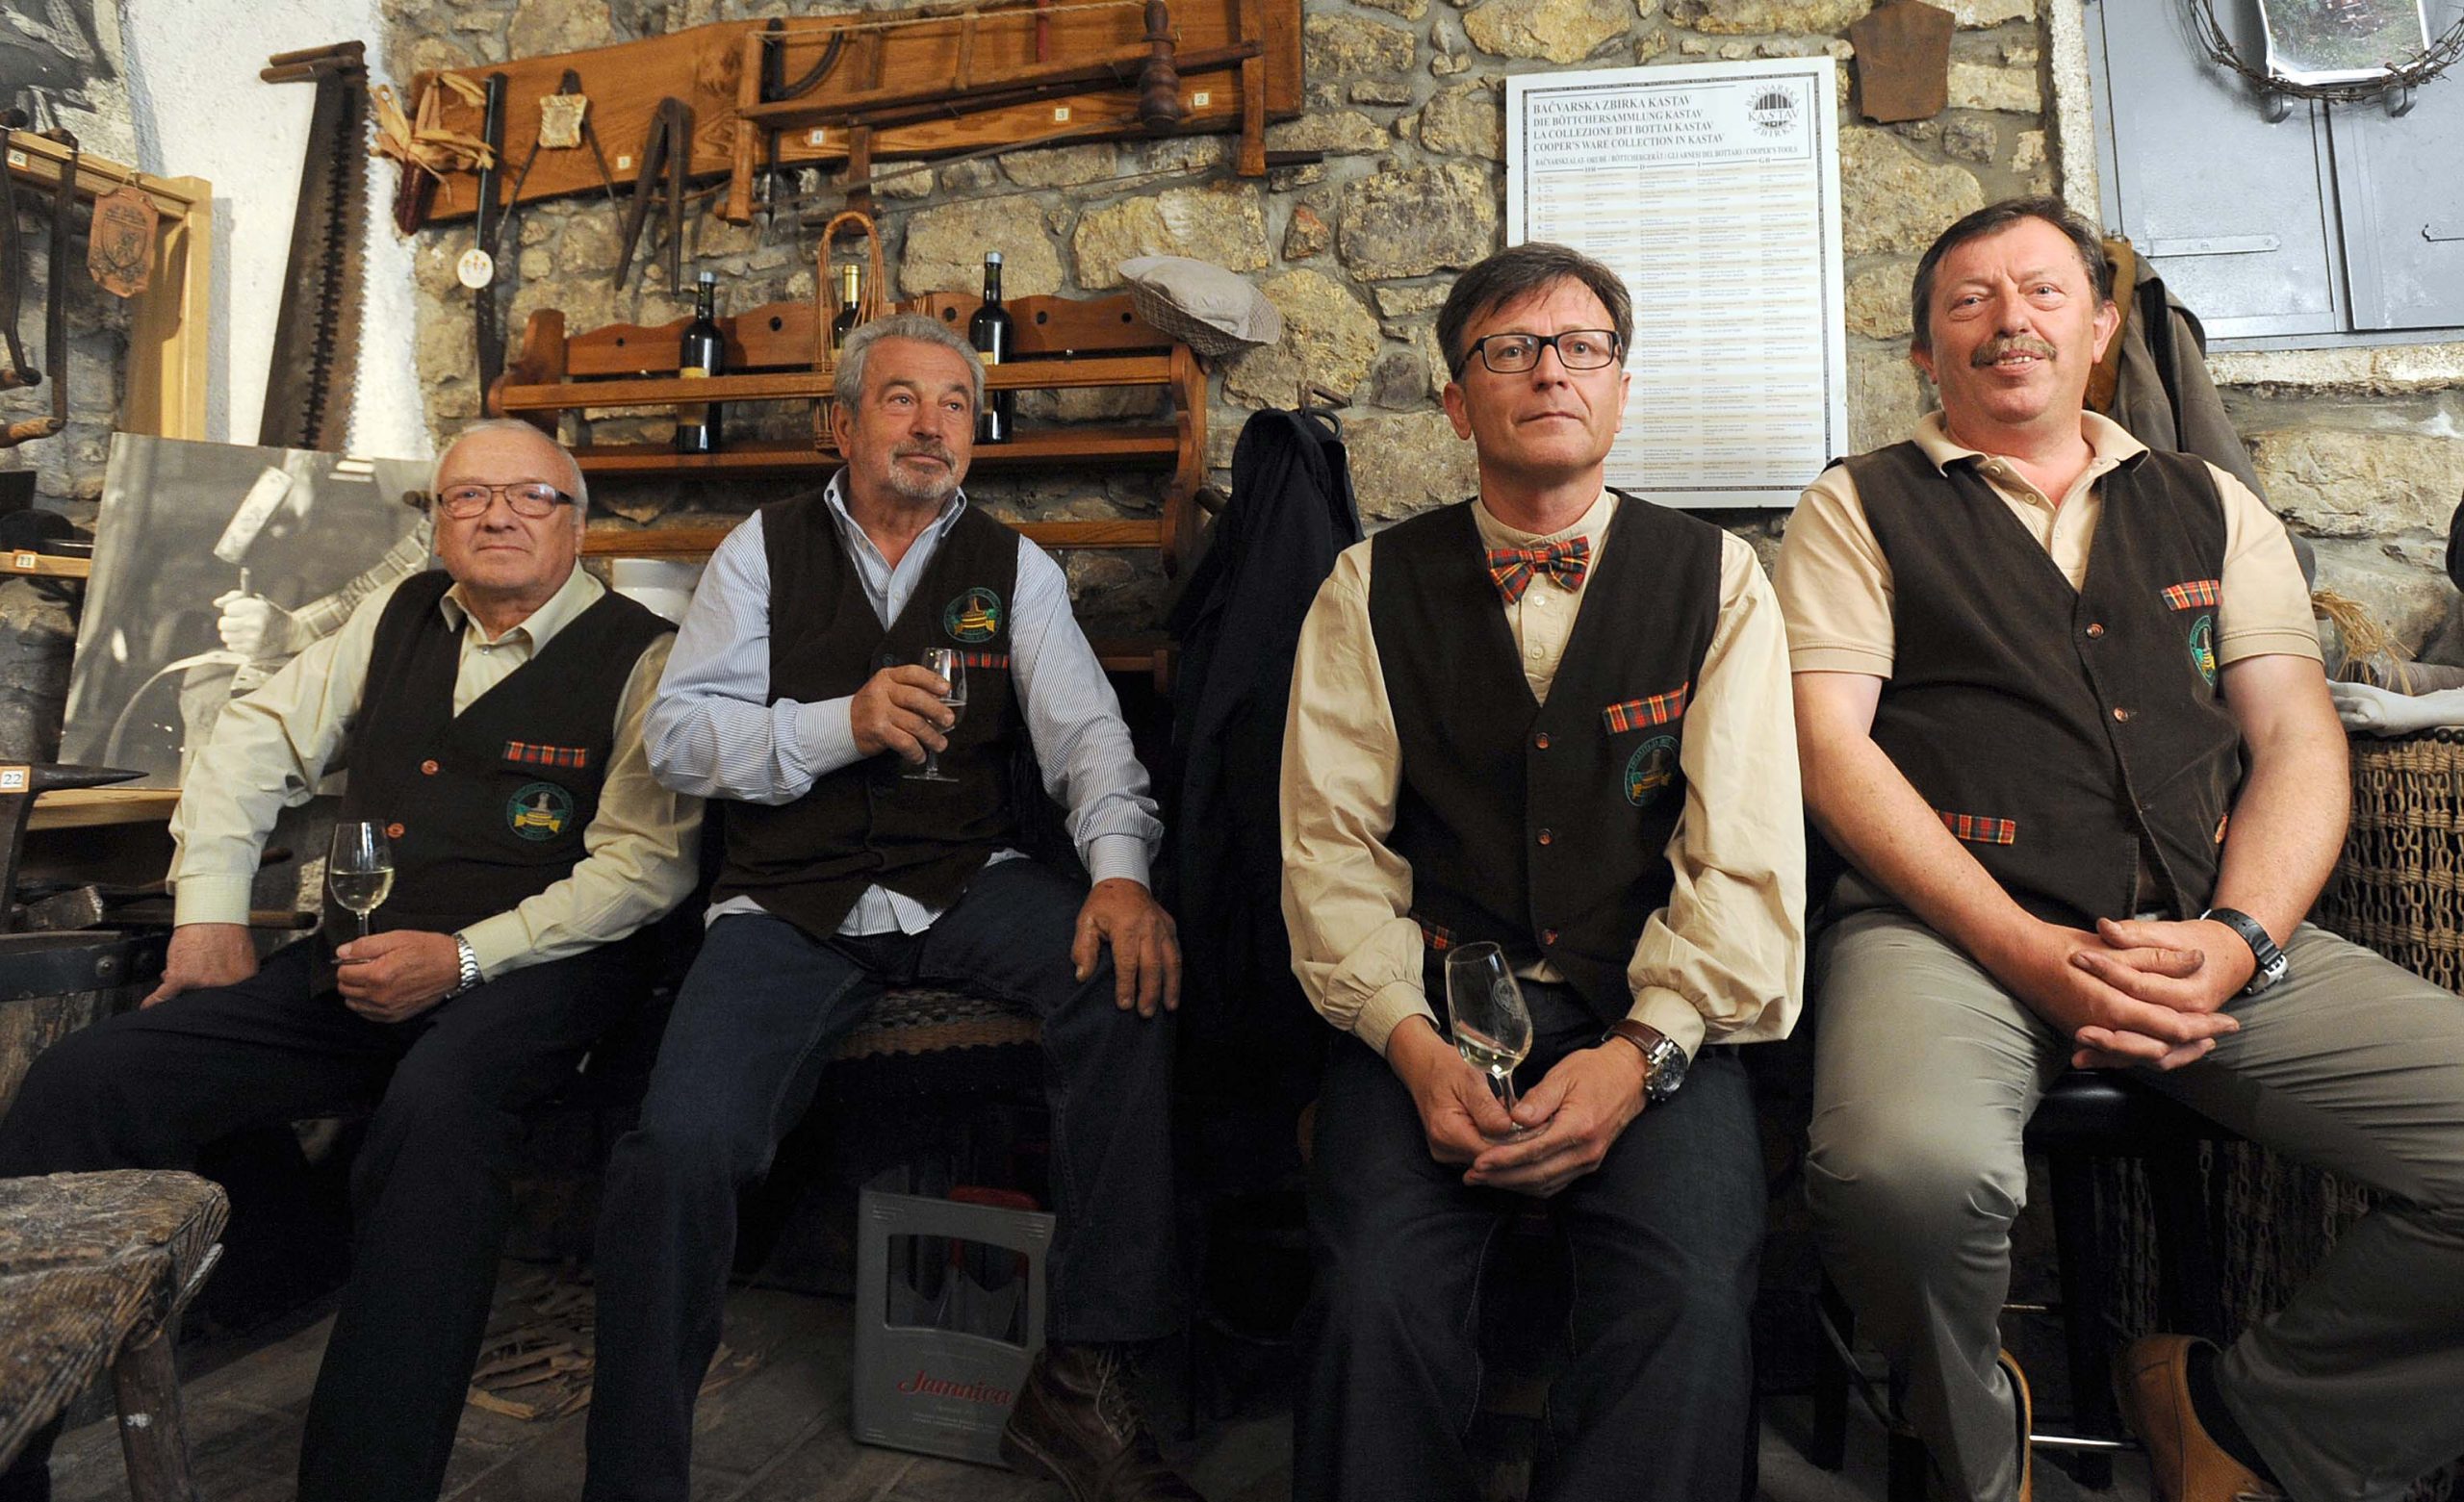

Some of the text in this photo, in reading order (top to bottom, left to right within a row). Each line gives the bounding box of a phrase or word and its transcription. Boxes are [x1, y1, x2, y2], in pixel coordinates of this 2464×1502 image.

[1533, 95, 1692, 115] BAČVARSKA ZBIRKA KASTAV
[1533, 109, 1704, 127] DIE BÖTTCHERSAMMLUNG KASTAV
[1748, 109, 1800, 122] KASTAV
[1533, 121, 1714, 140] LA COLLEZIONE DEI BOTTAI KASTAV
[1533, 133, 1725, 153] COOPER'S WARE COLLECTION IN KASTAV
[1777, 146, 1798, 155] TOOLS
[3, 774, 22, 785] 22
